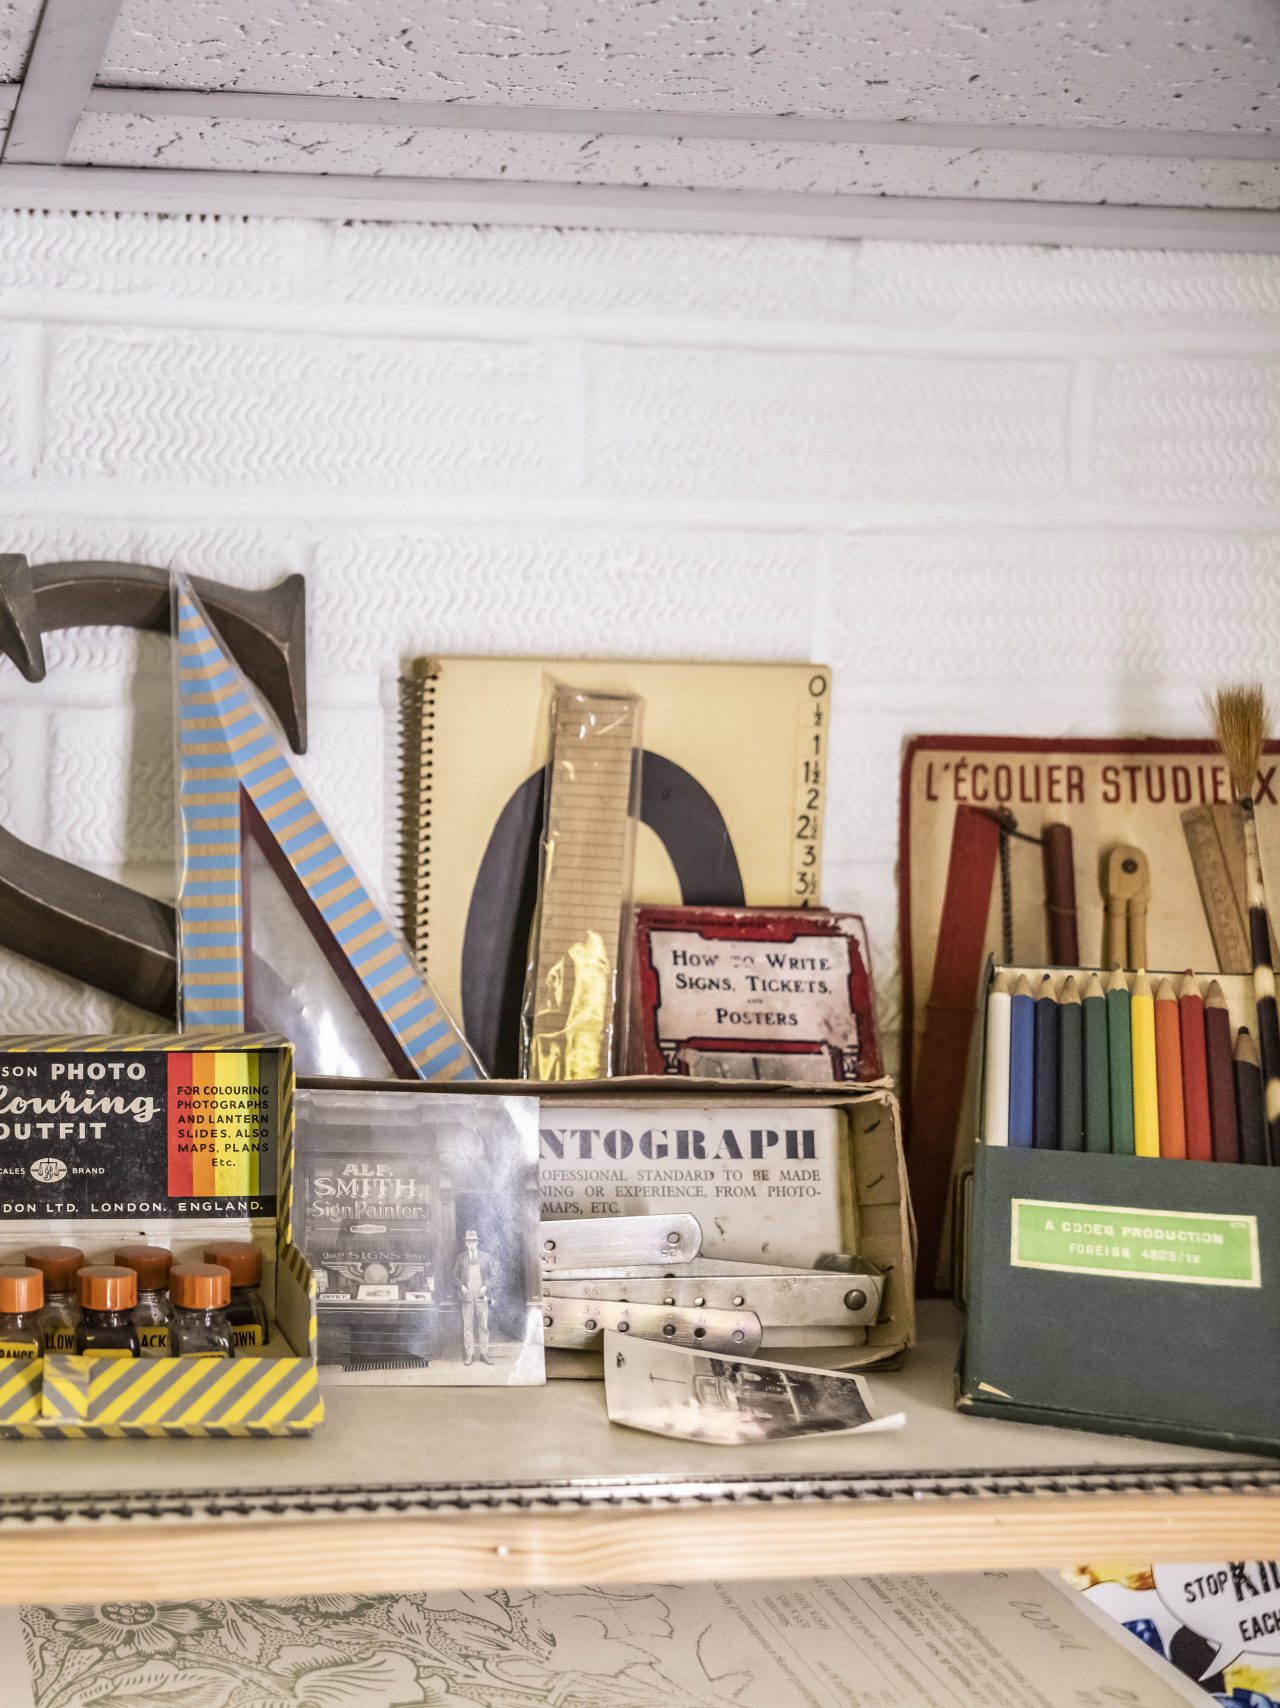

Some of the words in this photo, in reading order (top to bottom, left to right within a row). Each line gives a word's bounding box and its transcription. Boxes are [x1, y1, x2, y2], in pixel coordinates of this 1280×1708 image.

[807, 788, 819, 810] 2
[802, 845, 816, 867] 3
[51, 1063, 146, 1081] PHOTO
[177, 1086, 200, 1095] FOR
[203, 1086, 270, 1096] COLOURING
[177, 1100, 269, 1109] PHOTOGRAPHS
[177, 1115, 205, 1124] AND
[209, 1115, 269, 1124] LANTERN
[235, 1129, 269, 1138] ALSO
[177, 1143, 220, 1154] MAPS,
[224, 1143, 269, 1153] PLANS
[211, 1158, 236, 1168] Etc.
[72, 1167, 105, 1175] BRAND
[637, 1169, 715, 1182] STANDARD
[724, 1169, 743, 1182] TO
[753, 1169, 770, 1181] BE
[779, 1169, 822, 1182] MADE
[584, 1187, 606, 1198] OR
[615, 1185, 708, 1200] EXPERIENCE,
[715, 1185, 757, 1198] FROM
[767, 1185, 822, 1198] PHOTO-
[47, 1203, 79, 1213] LTD.
[312, 1200, 352, 1223] Sign
[591, 1202, 623, 1214] ETC.
[1045, 1220, 1055, 1232] A
[1122, 1226, 1224, 1245] PRODUCTION
[348, 1251, 401, 1260] SIGNS
[1069, 1243, 1131, 1259] FOREIGN
[1184, 1570, 1228, 1604] STOP
